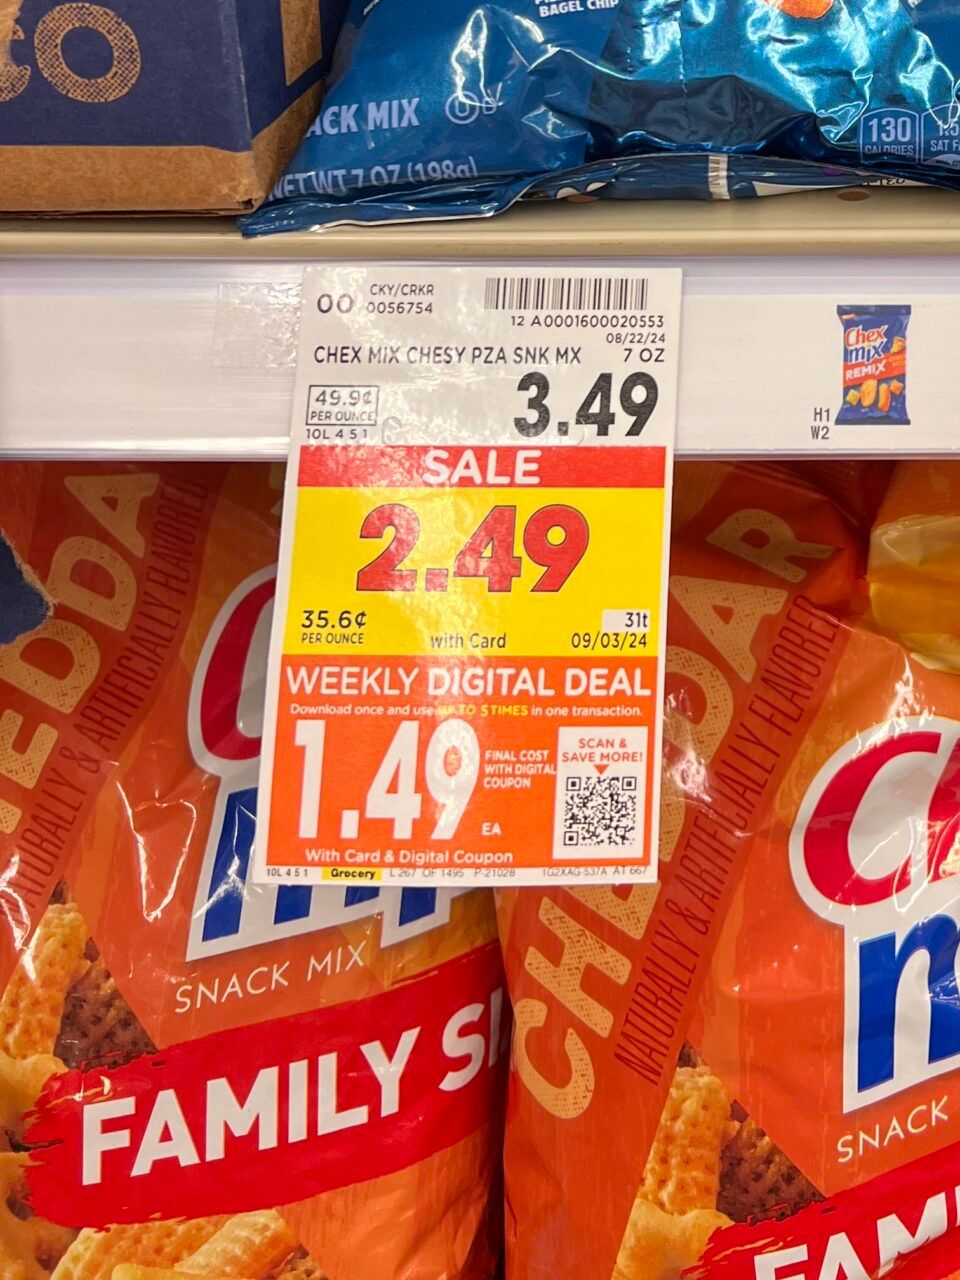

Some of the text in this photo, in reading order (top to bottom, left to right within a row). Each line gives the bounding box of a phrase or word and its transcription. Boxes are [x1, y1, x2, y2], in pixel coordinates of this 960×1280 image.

[539, 1, 585, 18] BAGEL
[366, 98, 420, 132] MIX
[868, 116, 912, 144] 130
[864, 144, 915, 156] CALORIES
[930, 139, 949, 152] SAT
[268, 173, 308, 202] NET
[309, 168, 348, 195] WT
[351, 168, 365, 189] 7
[369, 164, 401, 187] OZ
[370, 283, 434, 297] CKY/CRKR
[366, 301, 433, 315] 0056754
[511, 315, 665, 328] 12 A0001600020553
[605, 332, 666, 345] 08/22/24
[845, 325, 888, 348] Chex
[313, 346, 665, 365] CHEX MIX CHESY PZA SNK MX 7 OZ
[849, 339, 887, 363] mix
[845, 360, 886, 381] REMIX
[315, 389, 373, 407] 49.9¢
[513, 371, 659, 438] 3.49
[310, 410, 376, 422] PER OUNCE
[813, 406, 830, 422] H1
[305, 428, 359, 440] 10L 4 5
[810, 425, 830, 440] W2
[422, 449, 542, 486] SALE
[356, 503, 590, 593] 2.49
[301, 609, 368, 630] 35.6¢
[301, 632, 365, 645] PER OUNCE
[430, 631, 648, 650] with Card 09/03/24
[75, 598, 183, 752] ARTIFICIALLY
[286, 666, 652, 697] WEEKLY DIGITAL DEAL
[290, 703, 352, 716] Download
[354, 705, 385, 716] once
[387, 703, 411, 716] and
[413, 705, 434, 716] use
[459, 703, 477, 716] TO
[480, 704, 489, 717] 5
[491, 704, 529, 716] TIMES
[531, 704, 543, 716] in
[545, 706, 569, 717] one
[572, 704, 642, 717] transaction.
[578, 738, 628, 748] SCAN &
[59, 745, 101, 774] &
[485, 749, 550, 761] FINAL COST
[562, 751, 643, 762] SAVE MORE!
[484, 763, 557, 775] WITH DIGITAL
[294, 718, 481, 841] 1.49
[483, 776, 532, 789] COUPON
[481, 823, 502, 836] EA
[680, 728, 783, 922] ARTIFICIALLY
[305, 848, 513, 867] With Card & Digital Coupon
[266, 868, 300, 877] 10L 4 5
[330, 868, 376, 880] Grocery
[397, 867, 416, 877] 267
[422, 867, 437, 877] OF
[677, 894, 712, 937] &
[173, 940, 367, 1014] SNACK MIX
[613, 918, 697, 1087] NATURALLY
[81, 1025, 422, 1187] FAMILY
[836, 1096, 950, 1164] SNACK
